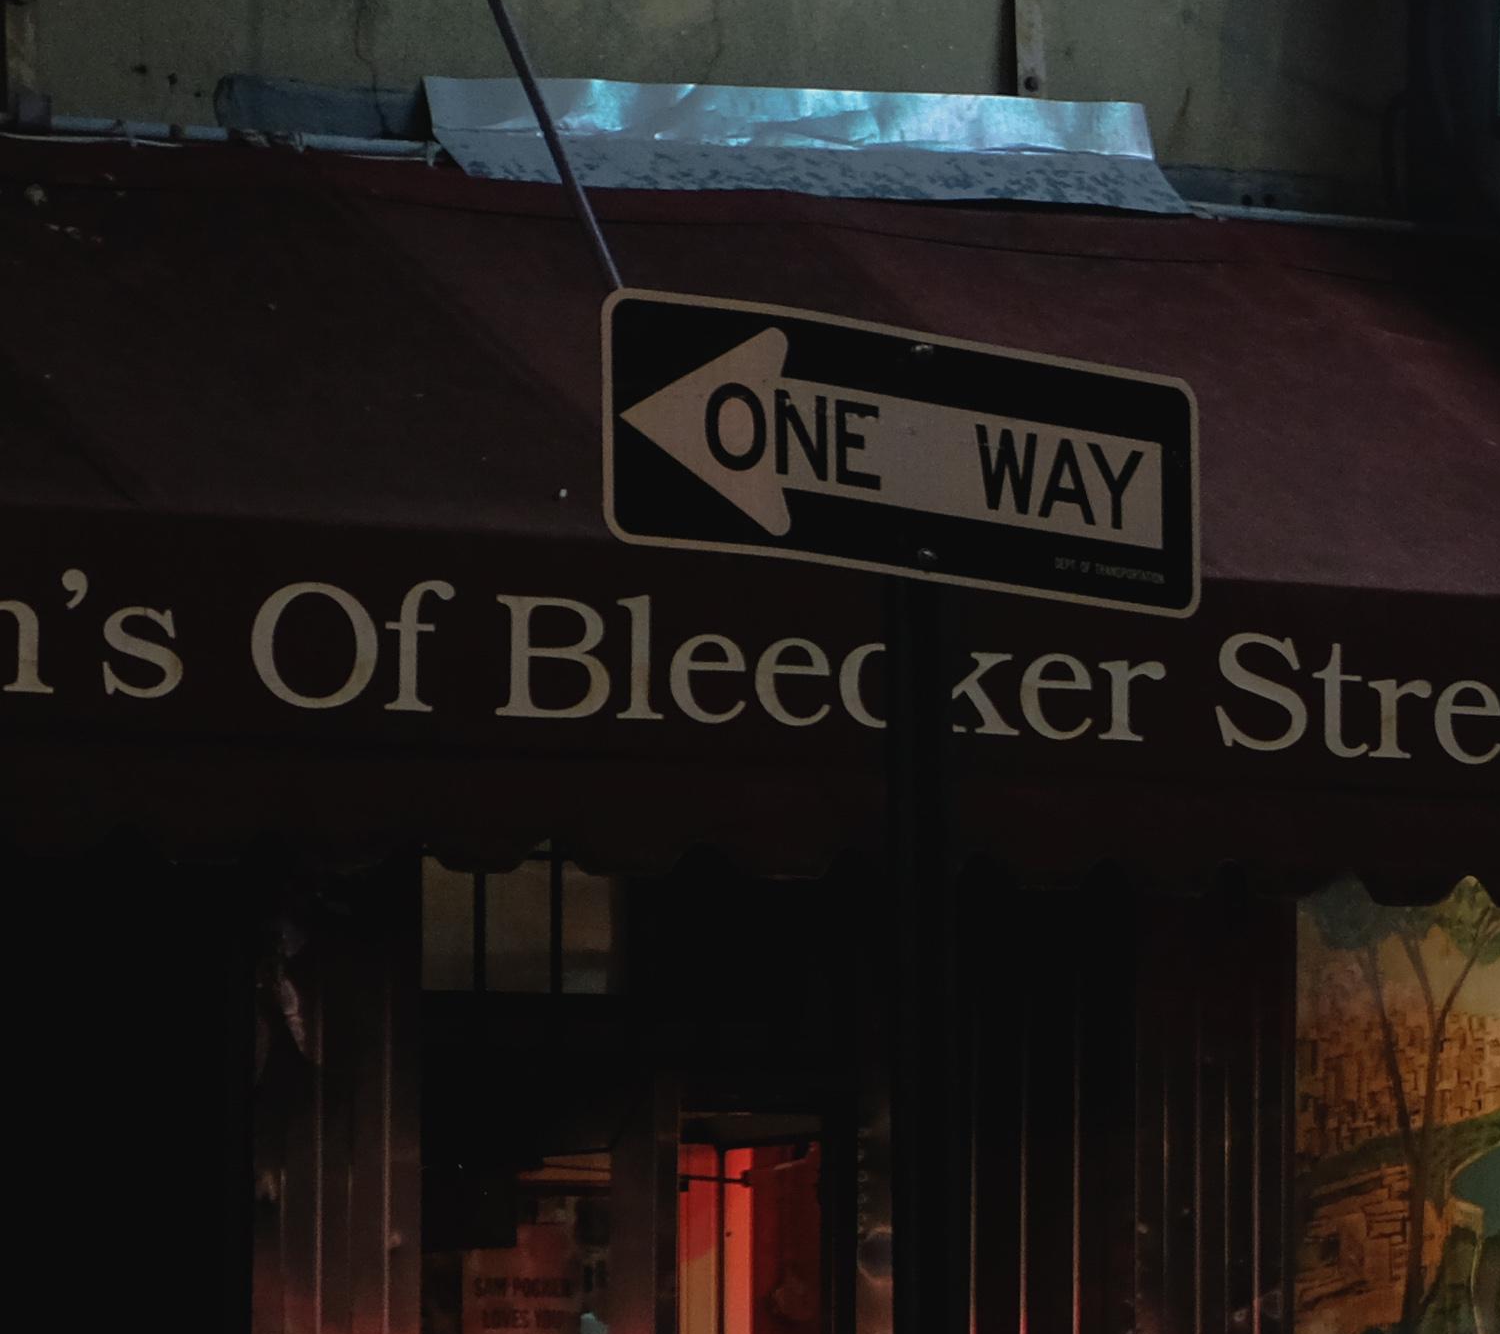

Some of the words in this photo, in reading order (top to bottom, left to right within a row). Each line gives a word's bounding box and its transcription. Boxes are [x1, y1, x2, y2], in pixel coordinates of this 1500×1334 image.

[705, 382, 881, 491] ONE
[974, 423, 1145, 530] WAY
[249, 579, 457, 715] Of
